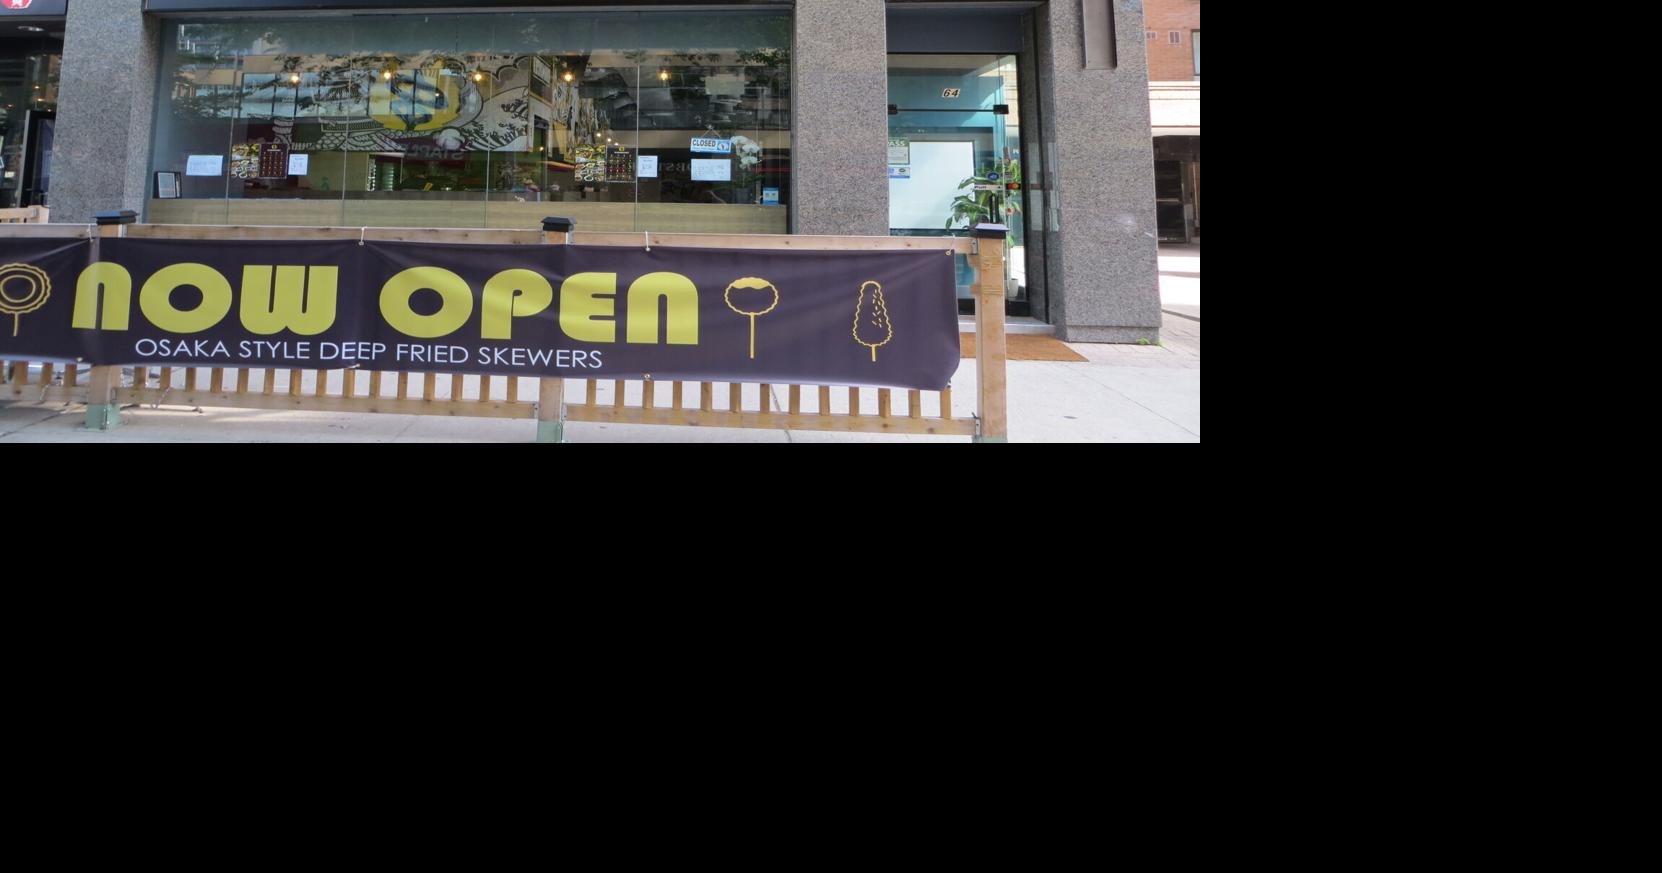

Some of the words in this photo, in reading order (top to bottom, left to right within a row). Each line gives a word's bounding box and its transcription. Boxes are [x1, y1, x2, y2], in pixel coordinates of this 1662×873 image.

[942, 88, 960, 98] 64
[692, 139, 716, 147] CLOSED
[72, 261, 339, 335] NOW
[379, 265, 699, 345] OPEN
[135, 338, 230, 358] OSAKA
[238, 340, 310, 359] STYLE
[319, 341, 386, 361] DEEP
[396, 343, 469, 364] FRIED
[477, 346, 603, 369] SKEWERS
